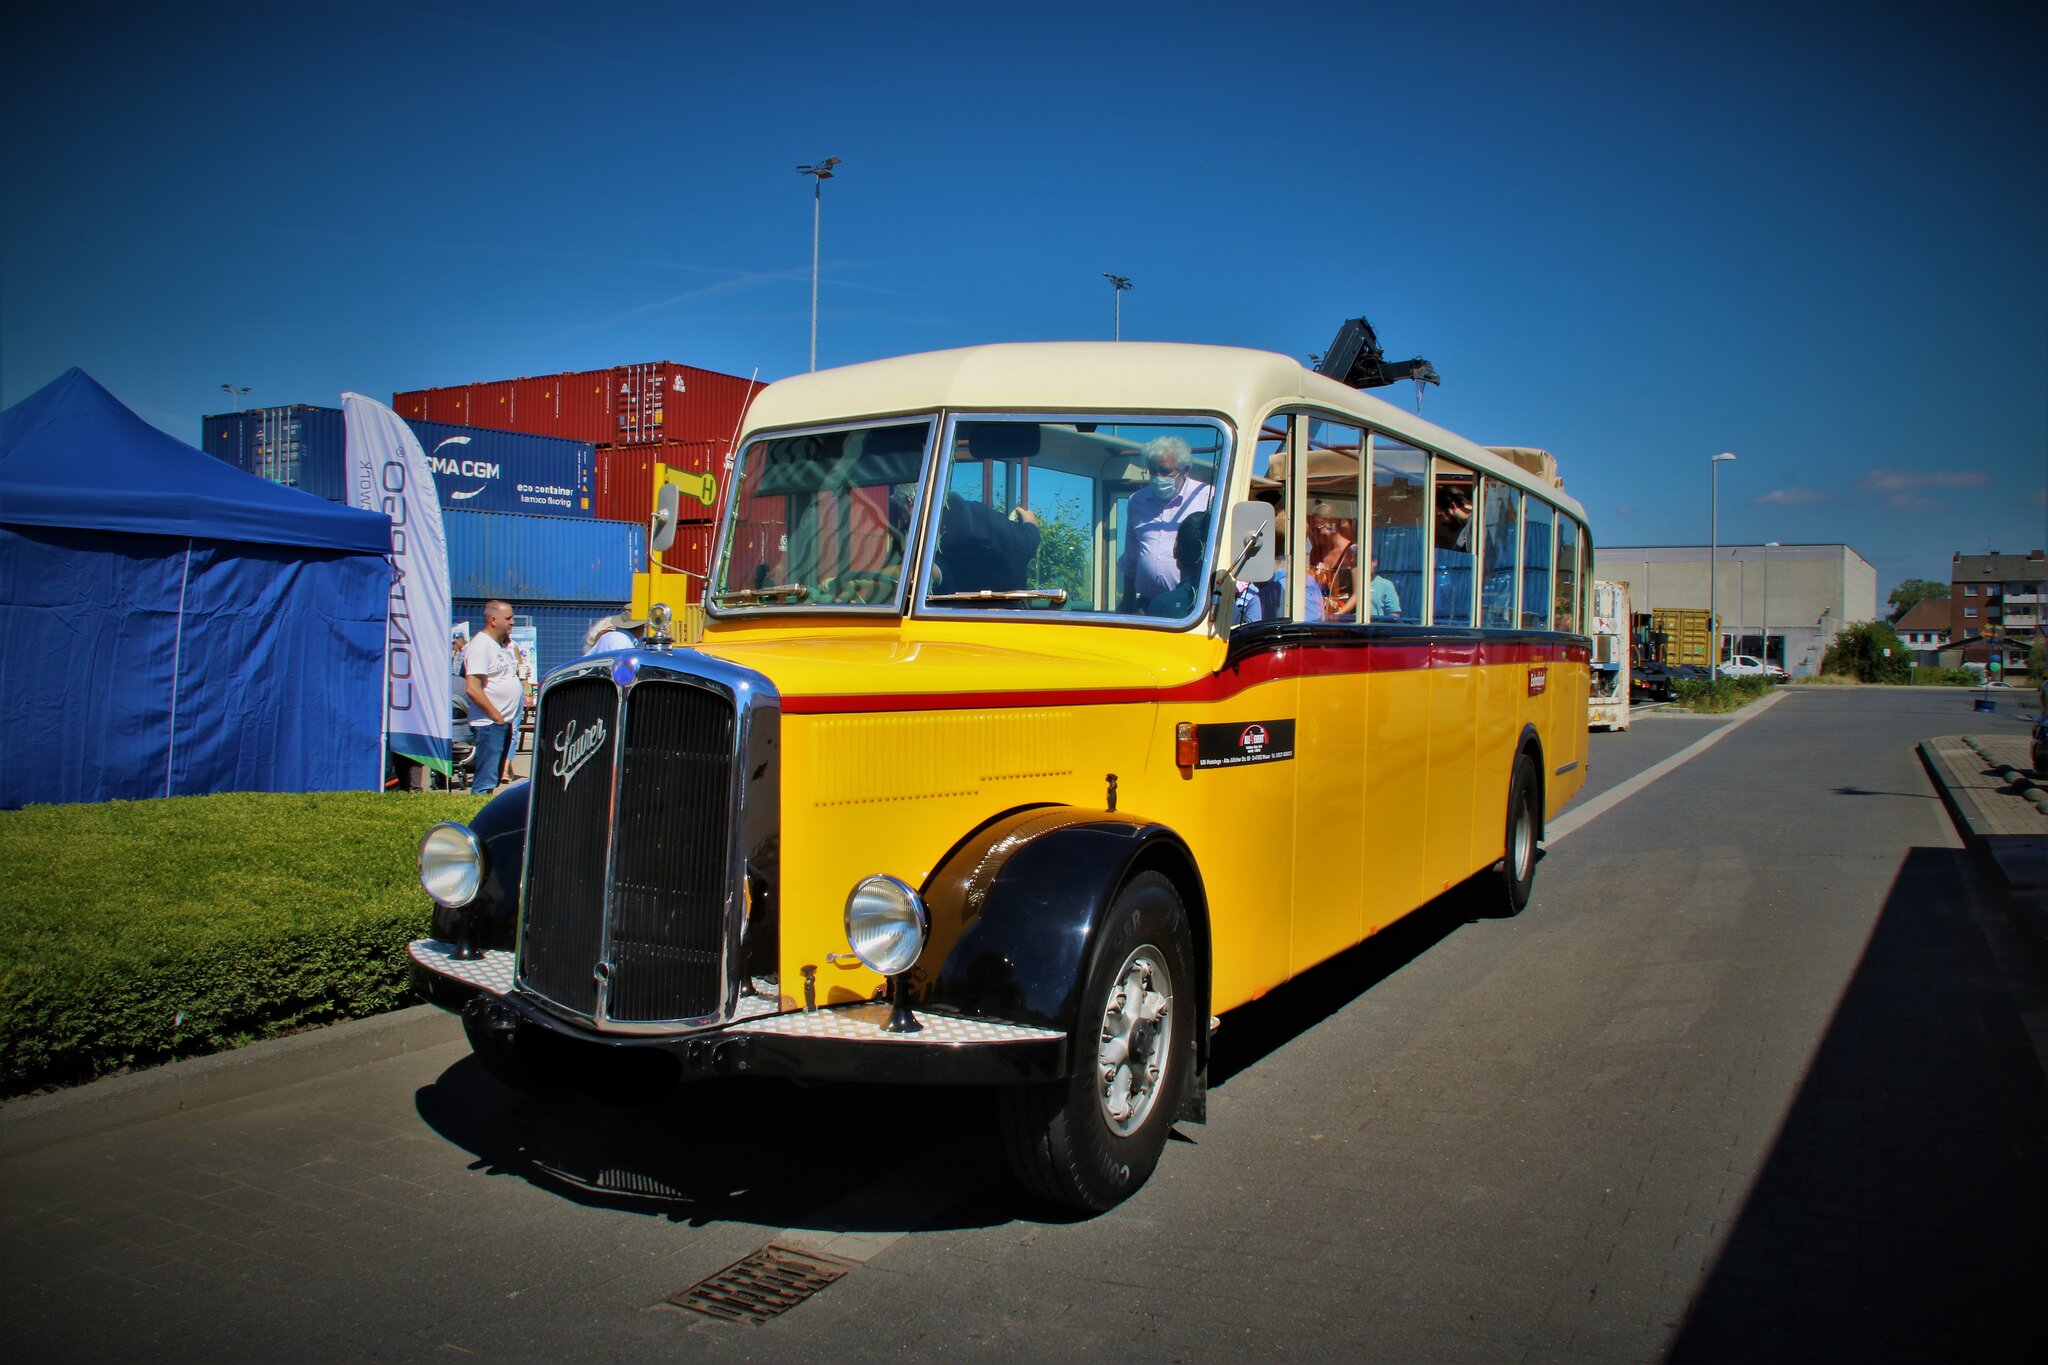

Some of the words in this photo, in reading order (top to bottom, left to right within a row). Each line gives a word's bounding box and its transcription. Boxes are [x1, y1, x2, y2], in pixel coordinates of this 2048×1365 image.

[461, 460, 499, 479] CGM
[517, 484, 533, 492] eco
[535, 486, 573, 496] container
[701, 477, 713, 500] H
